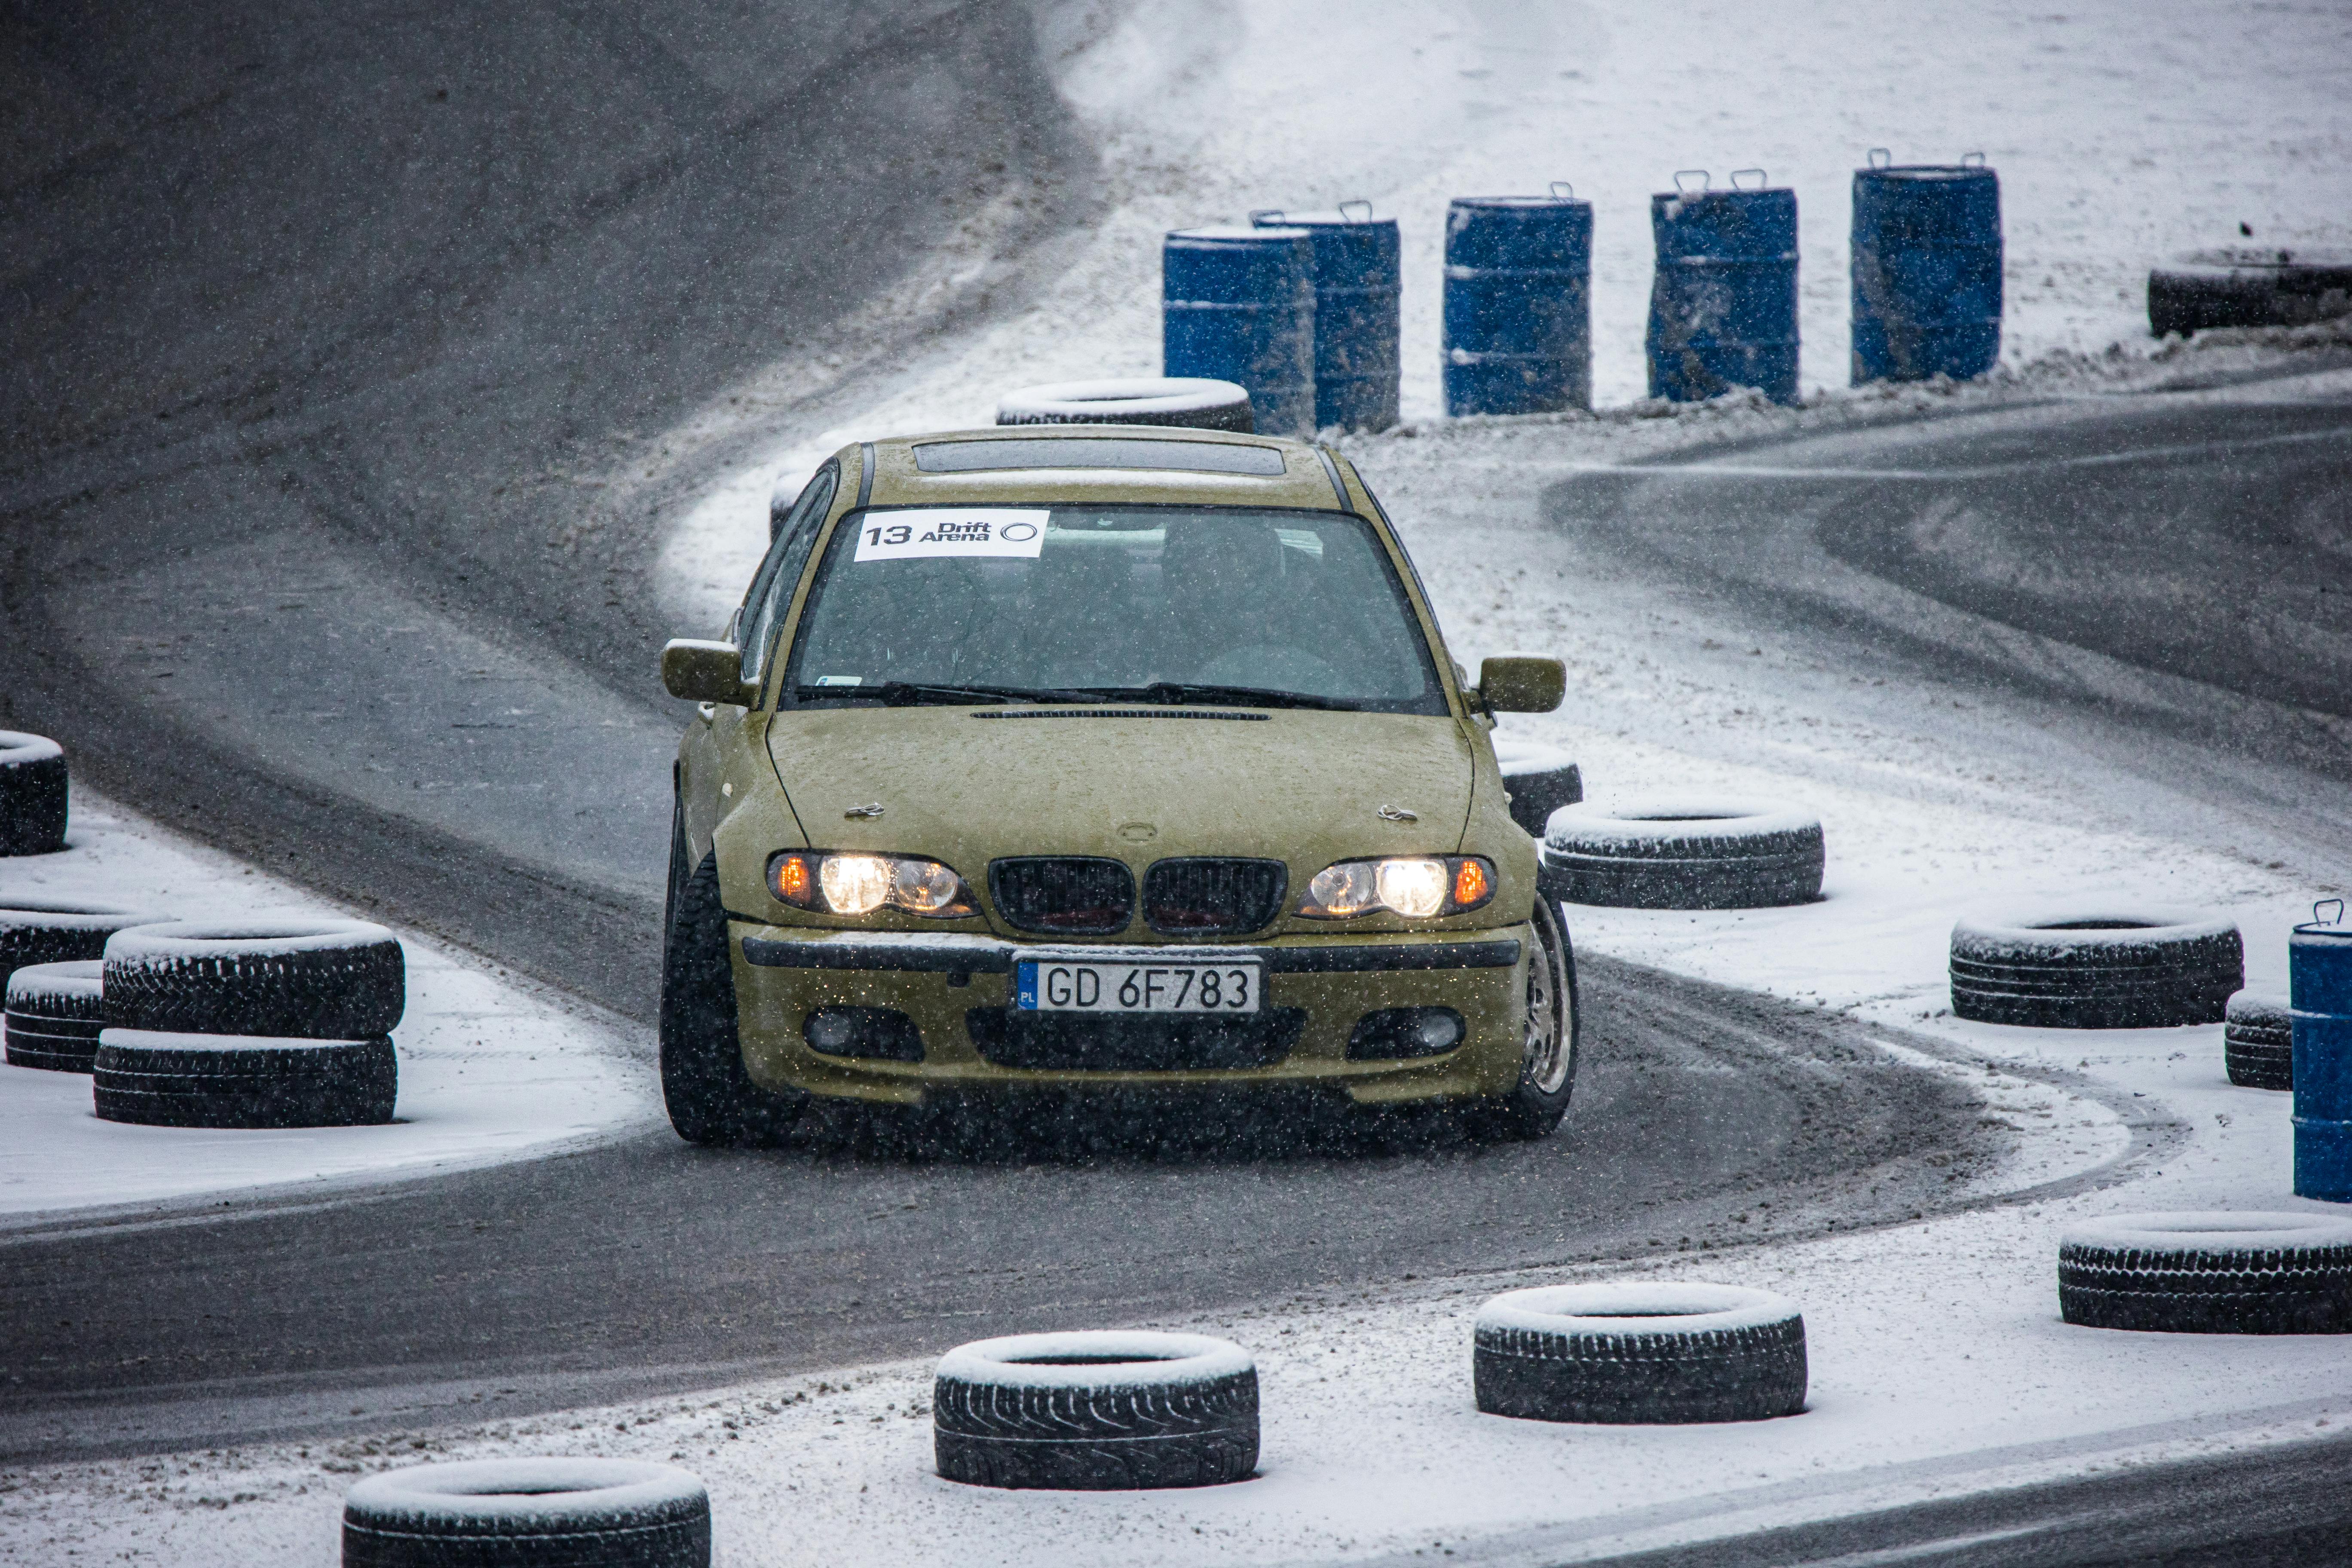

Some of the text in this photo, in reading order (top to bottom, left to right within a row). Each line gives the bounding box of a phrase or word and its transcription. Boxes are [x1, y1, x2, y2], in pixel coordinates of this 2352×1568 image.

[937, 522, 992, 533] Drift
[866, 525, 913, 546] 13
[918, 531, 990, 542] Arena
[1047, 967, 1248, 1009] GD 6F783
[1020, 992, 1035, 1003] PL
